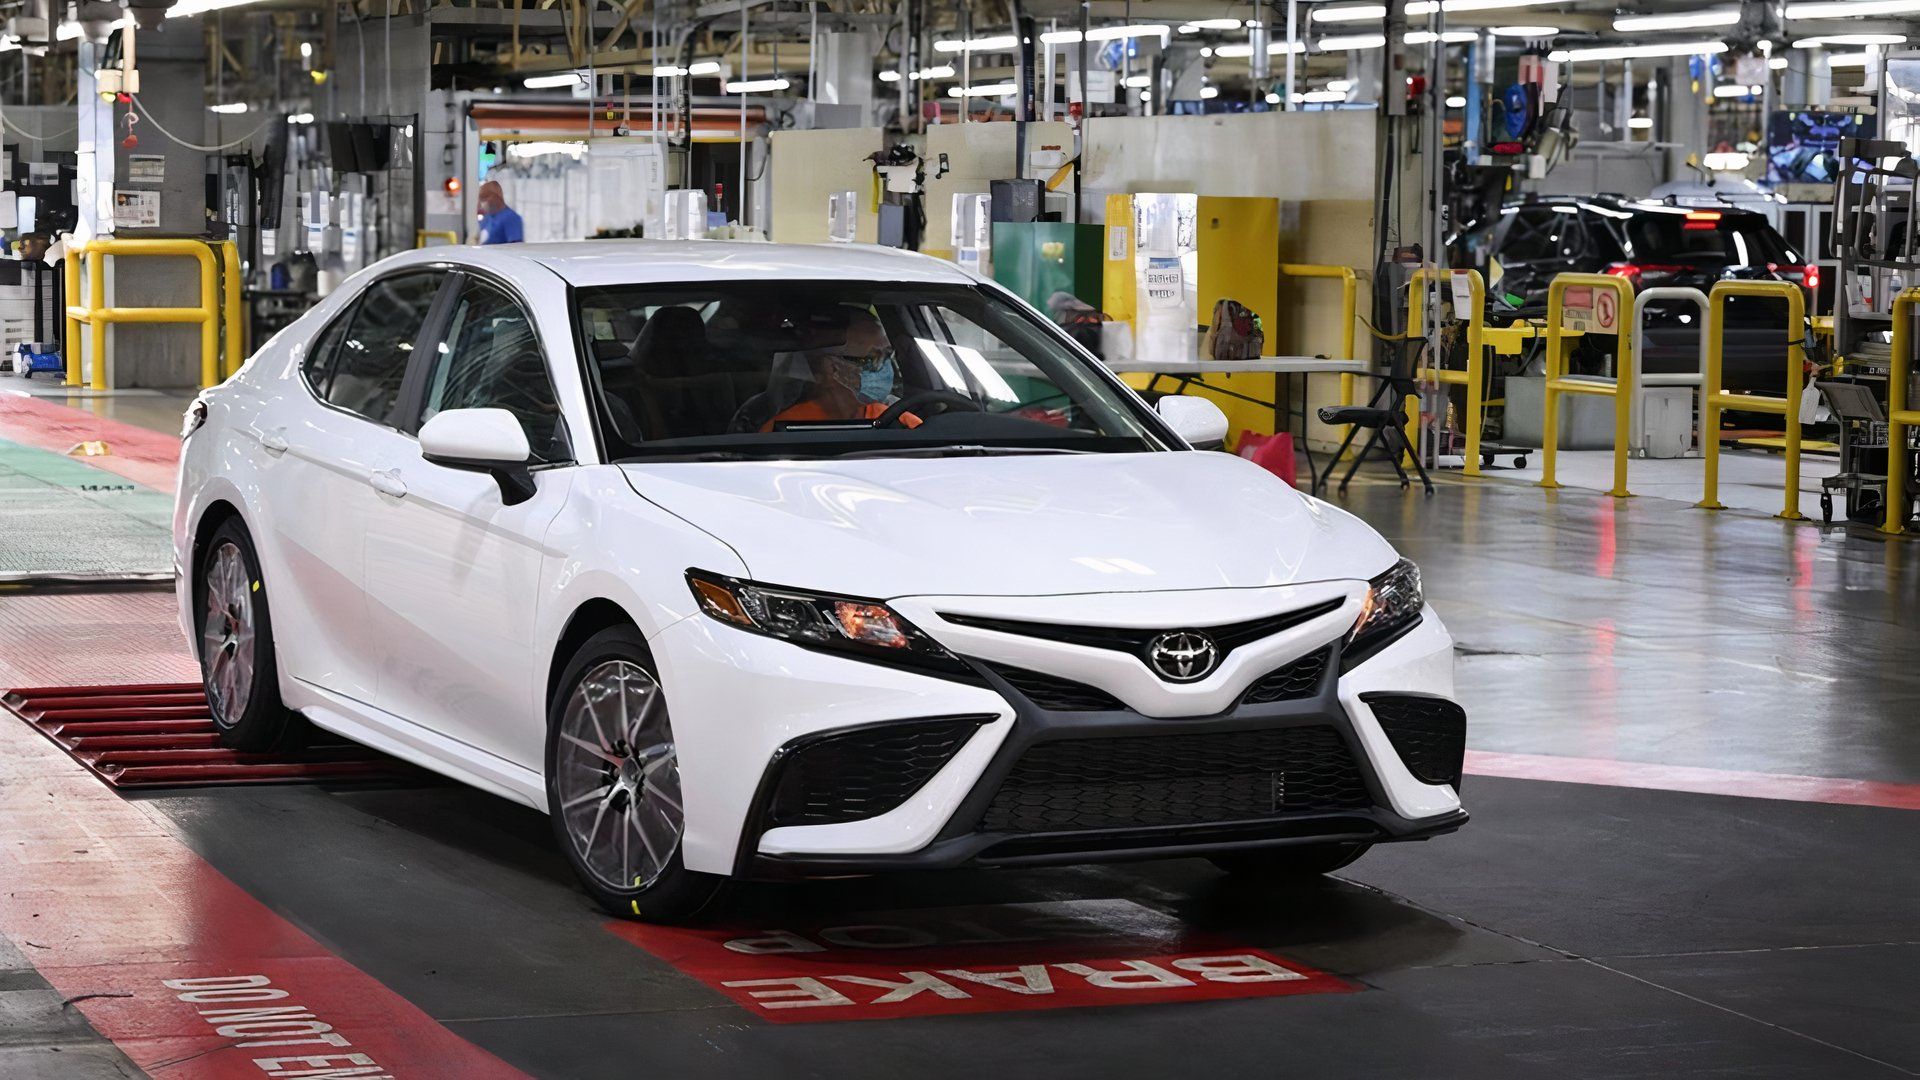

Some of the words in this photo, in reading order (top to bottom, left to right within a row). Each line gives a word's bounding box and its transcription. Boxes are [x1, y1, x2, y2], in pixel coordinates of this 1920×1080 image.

[161, 975, 290, 1003] DO
[720, 954, 1309, 1010] BRAKE
[198, 1005, 352, 1049] NOT
